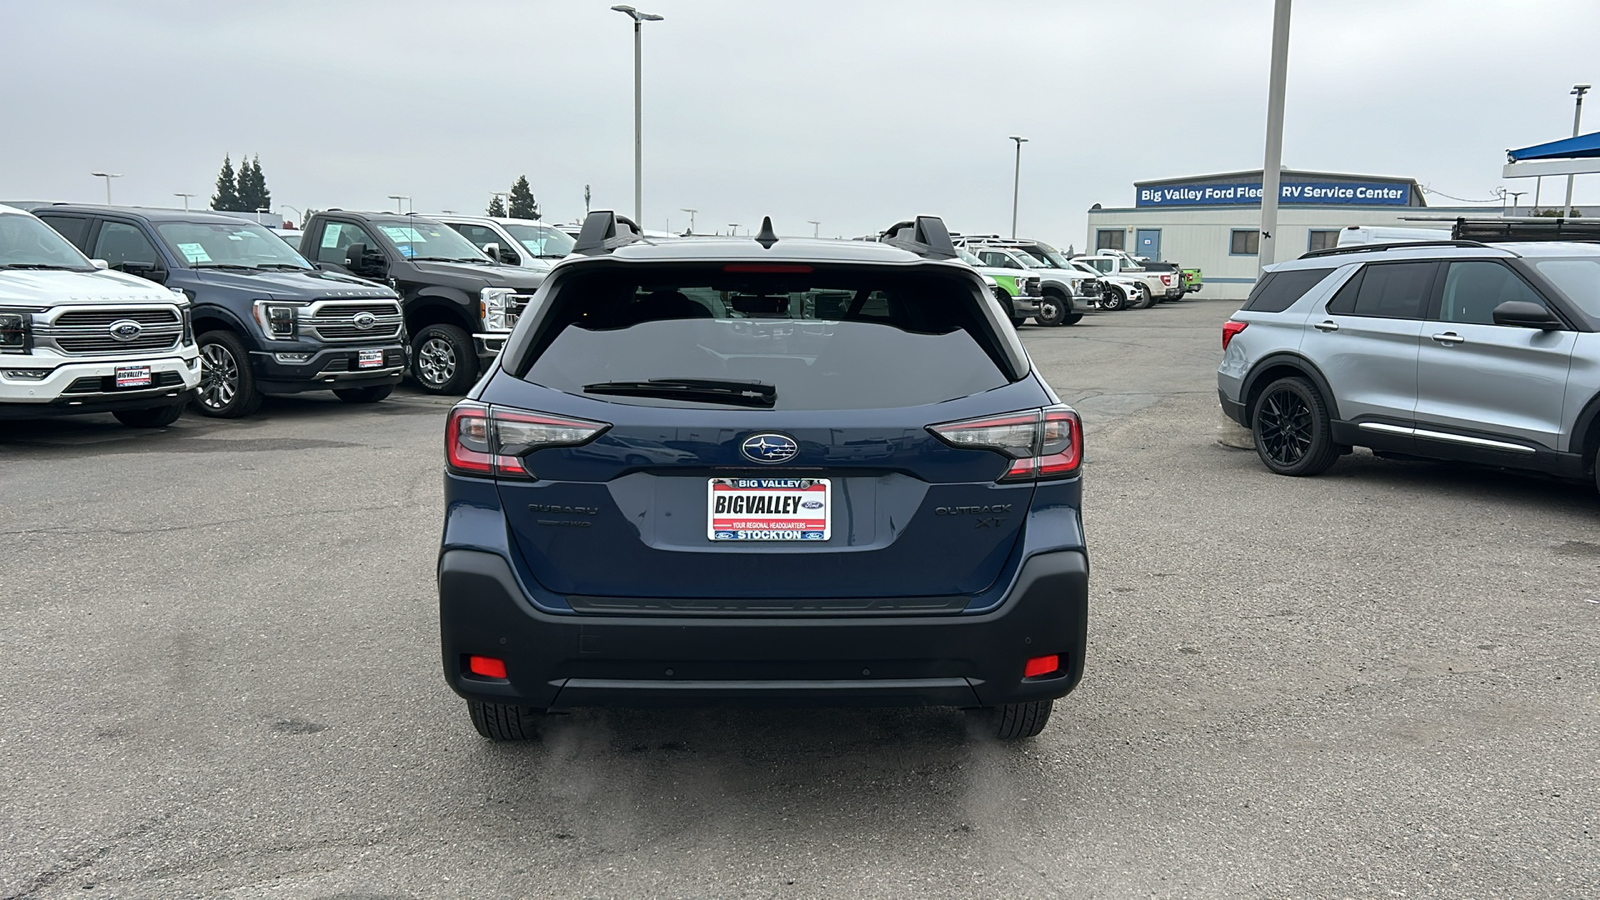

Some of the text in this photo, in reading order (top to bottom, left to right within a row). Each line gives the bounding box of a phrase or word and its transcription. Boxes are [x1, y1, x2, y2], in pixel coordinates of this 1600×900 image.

[1141, 186, 1403, 202] Big Valley Ford Flee RV Service Center
[120, 326, 136, 334] Ford
[738, 480, 801, 488] BIG VALLEY
[528, 503, 599, 515] SUBARU
[715, 495, 803, 514] BIGVALLEY
[935, 503, 1012, 515] OUTBACK
[769, 522, 806, 530] HEADQUARTERS
[737, 530, 801, 540] STOCKTON
